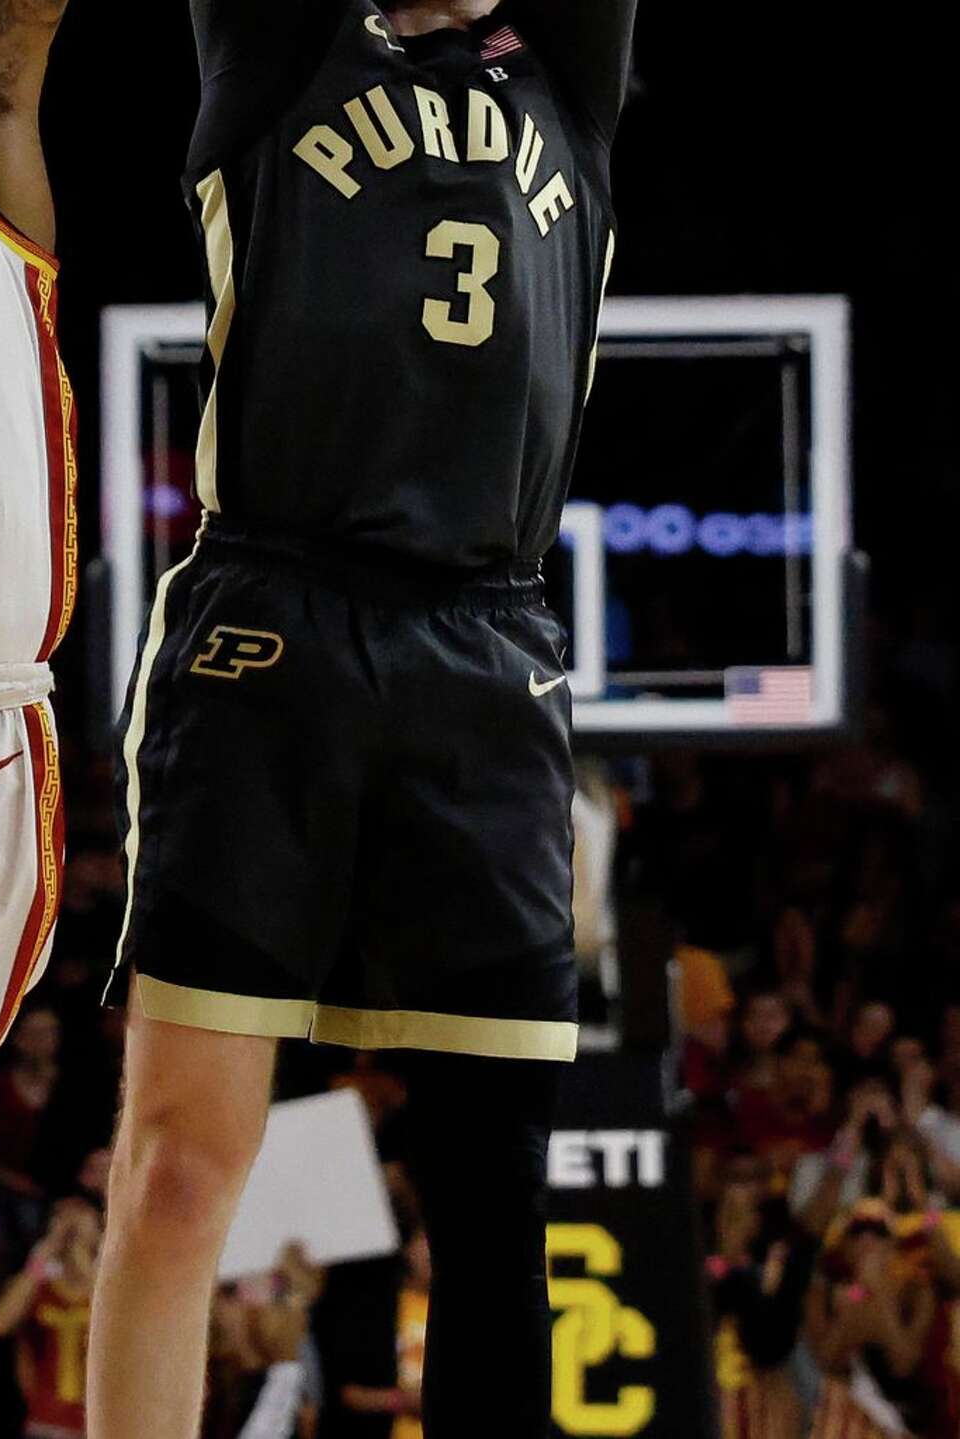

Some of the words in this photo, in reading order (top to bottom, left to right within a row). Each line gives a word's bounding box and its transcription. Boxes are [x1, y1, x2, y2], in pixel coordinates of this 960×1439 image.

[292, 84, 575, 238] PURDUE
[422, 220, 500, 347] 3
[190, 625, 284, 679] P
